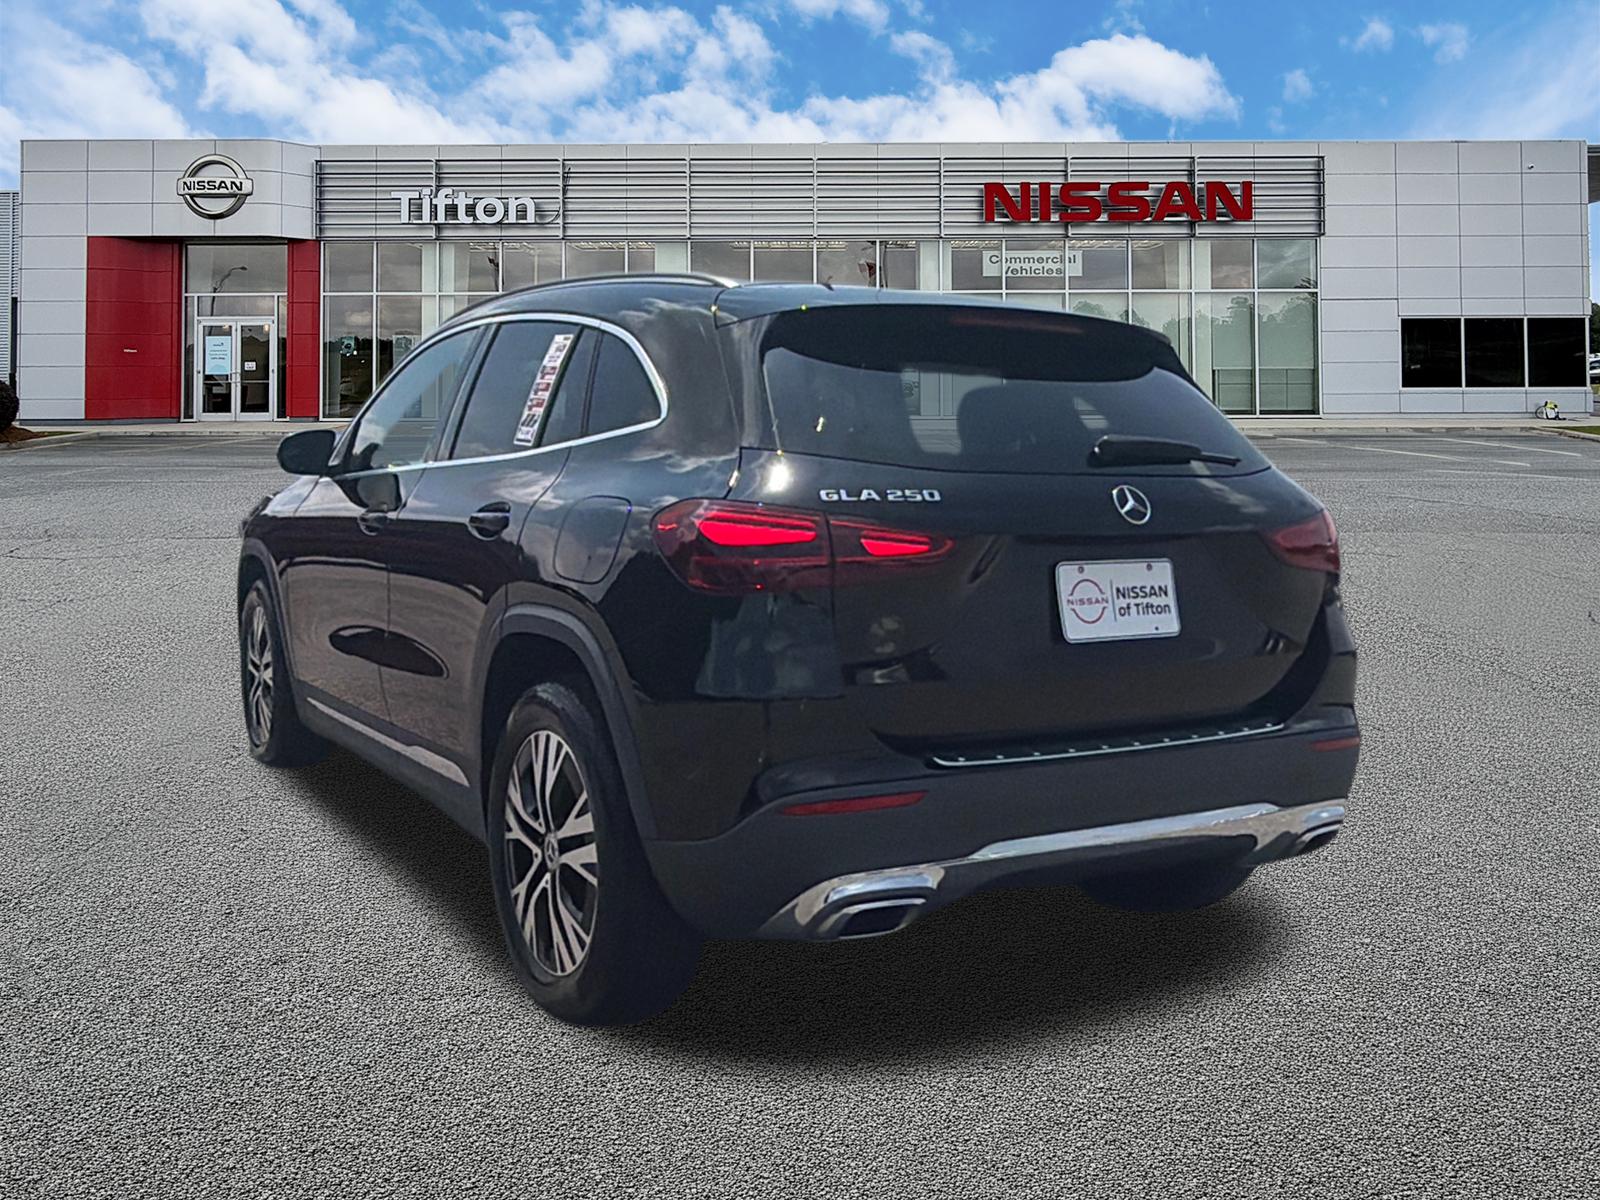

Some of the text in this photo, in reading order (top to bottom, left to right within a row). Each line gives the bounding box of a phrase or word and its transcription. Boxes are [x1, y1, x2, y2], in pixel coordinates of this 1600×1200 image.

[182, 180, 243, 192] NISSAN
[391, 188, 536, 224] Tifton
[983, 181, 1253, 223] NISSAN
[819, 489, 941, 501] GLA 250
[1115, 585, 1169, 600] NISSAN
[1067, 597, 1109, 606] NISSAN
[1118, 602, 1171, 617] of Tifton
